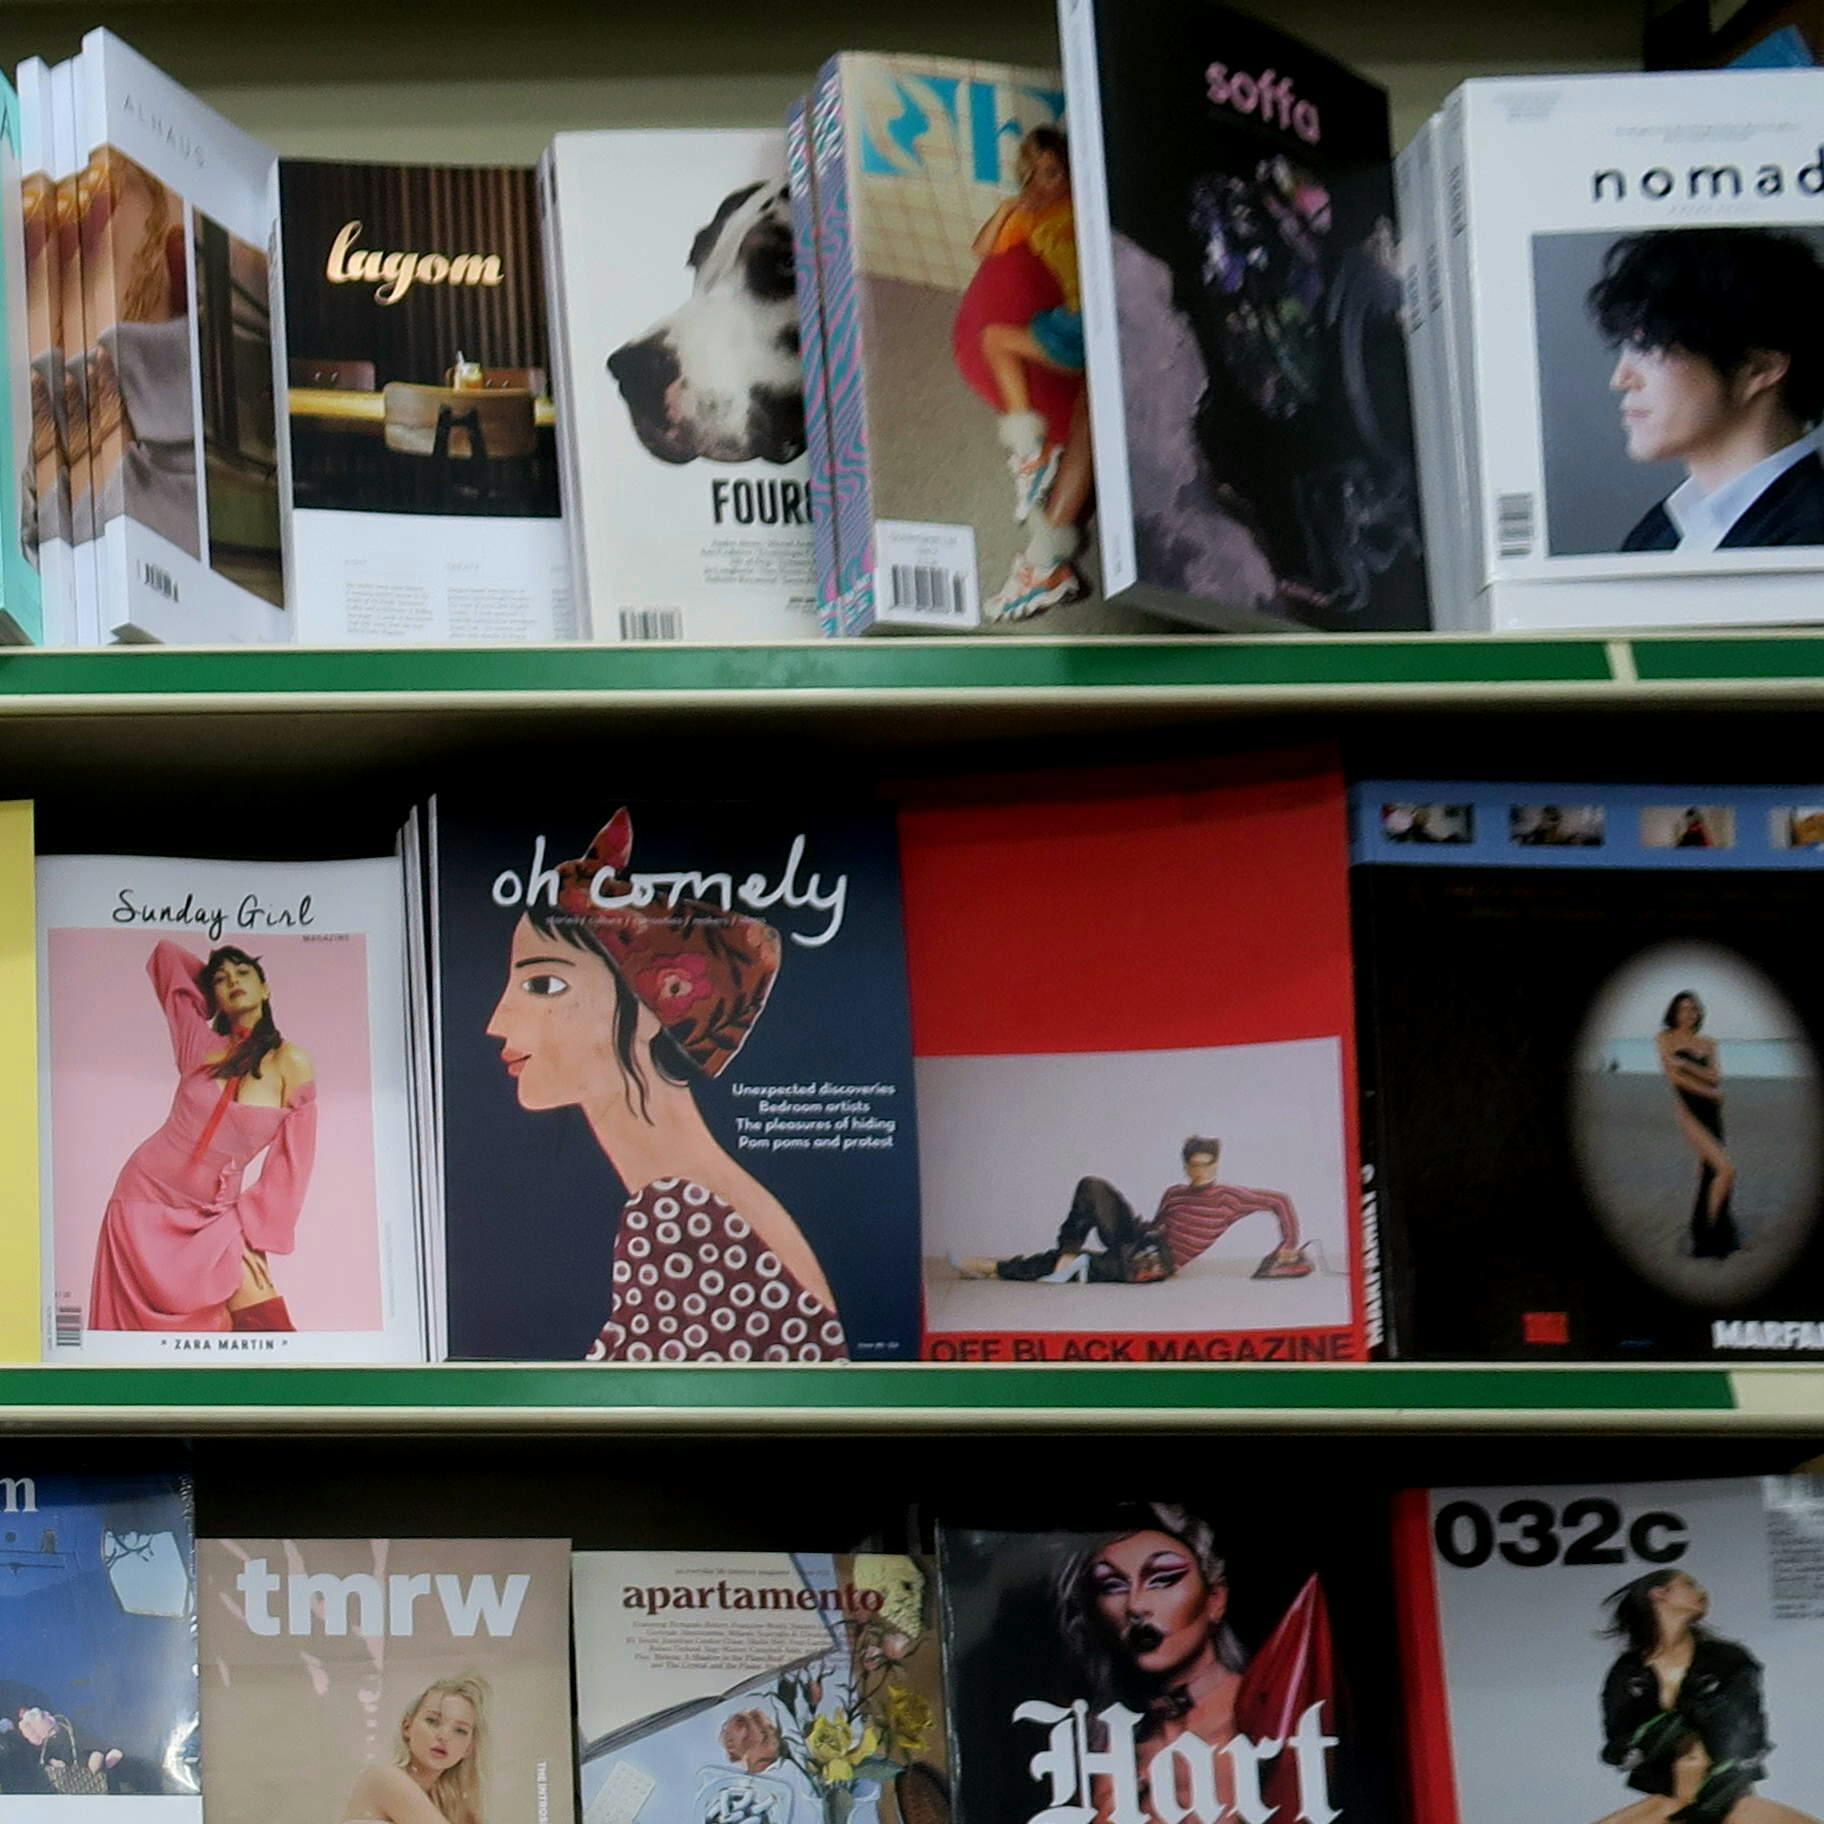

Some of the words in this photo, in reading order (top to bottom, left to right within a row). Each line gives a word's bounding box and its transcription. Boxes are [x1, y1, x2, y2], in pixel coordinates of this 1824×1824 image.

[1591, 155, 1824, 202] nomad
[326, 220, 505, 306] lagom
[112, 888, 229, 941] Sunday
[237, 891, 317, 928] Girl
[492, 834, 559, 907] oh
[589, 833, 849, 947] comely
[732, 1081, 814, 1098] Unexpected
[818, 1081, 896, 1097] discoveries
[173, 1337, 214, 1351] ZARA
[218, 1337, 277, 1352] MARTIN
[1434, 1496, 1691, 1569] 032c
[236, 1556, 532, 1638] tmrw
[622, 1577, 886, 1617] apartamento
